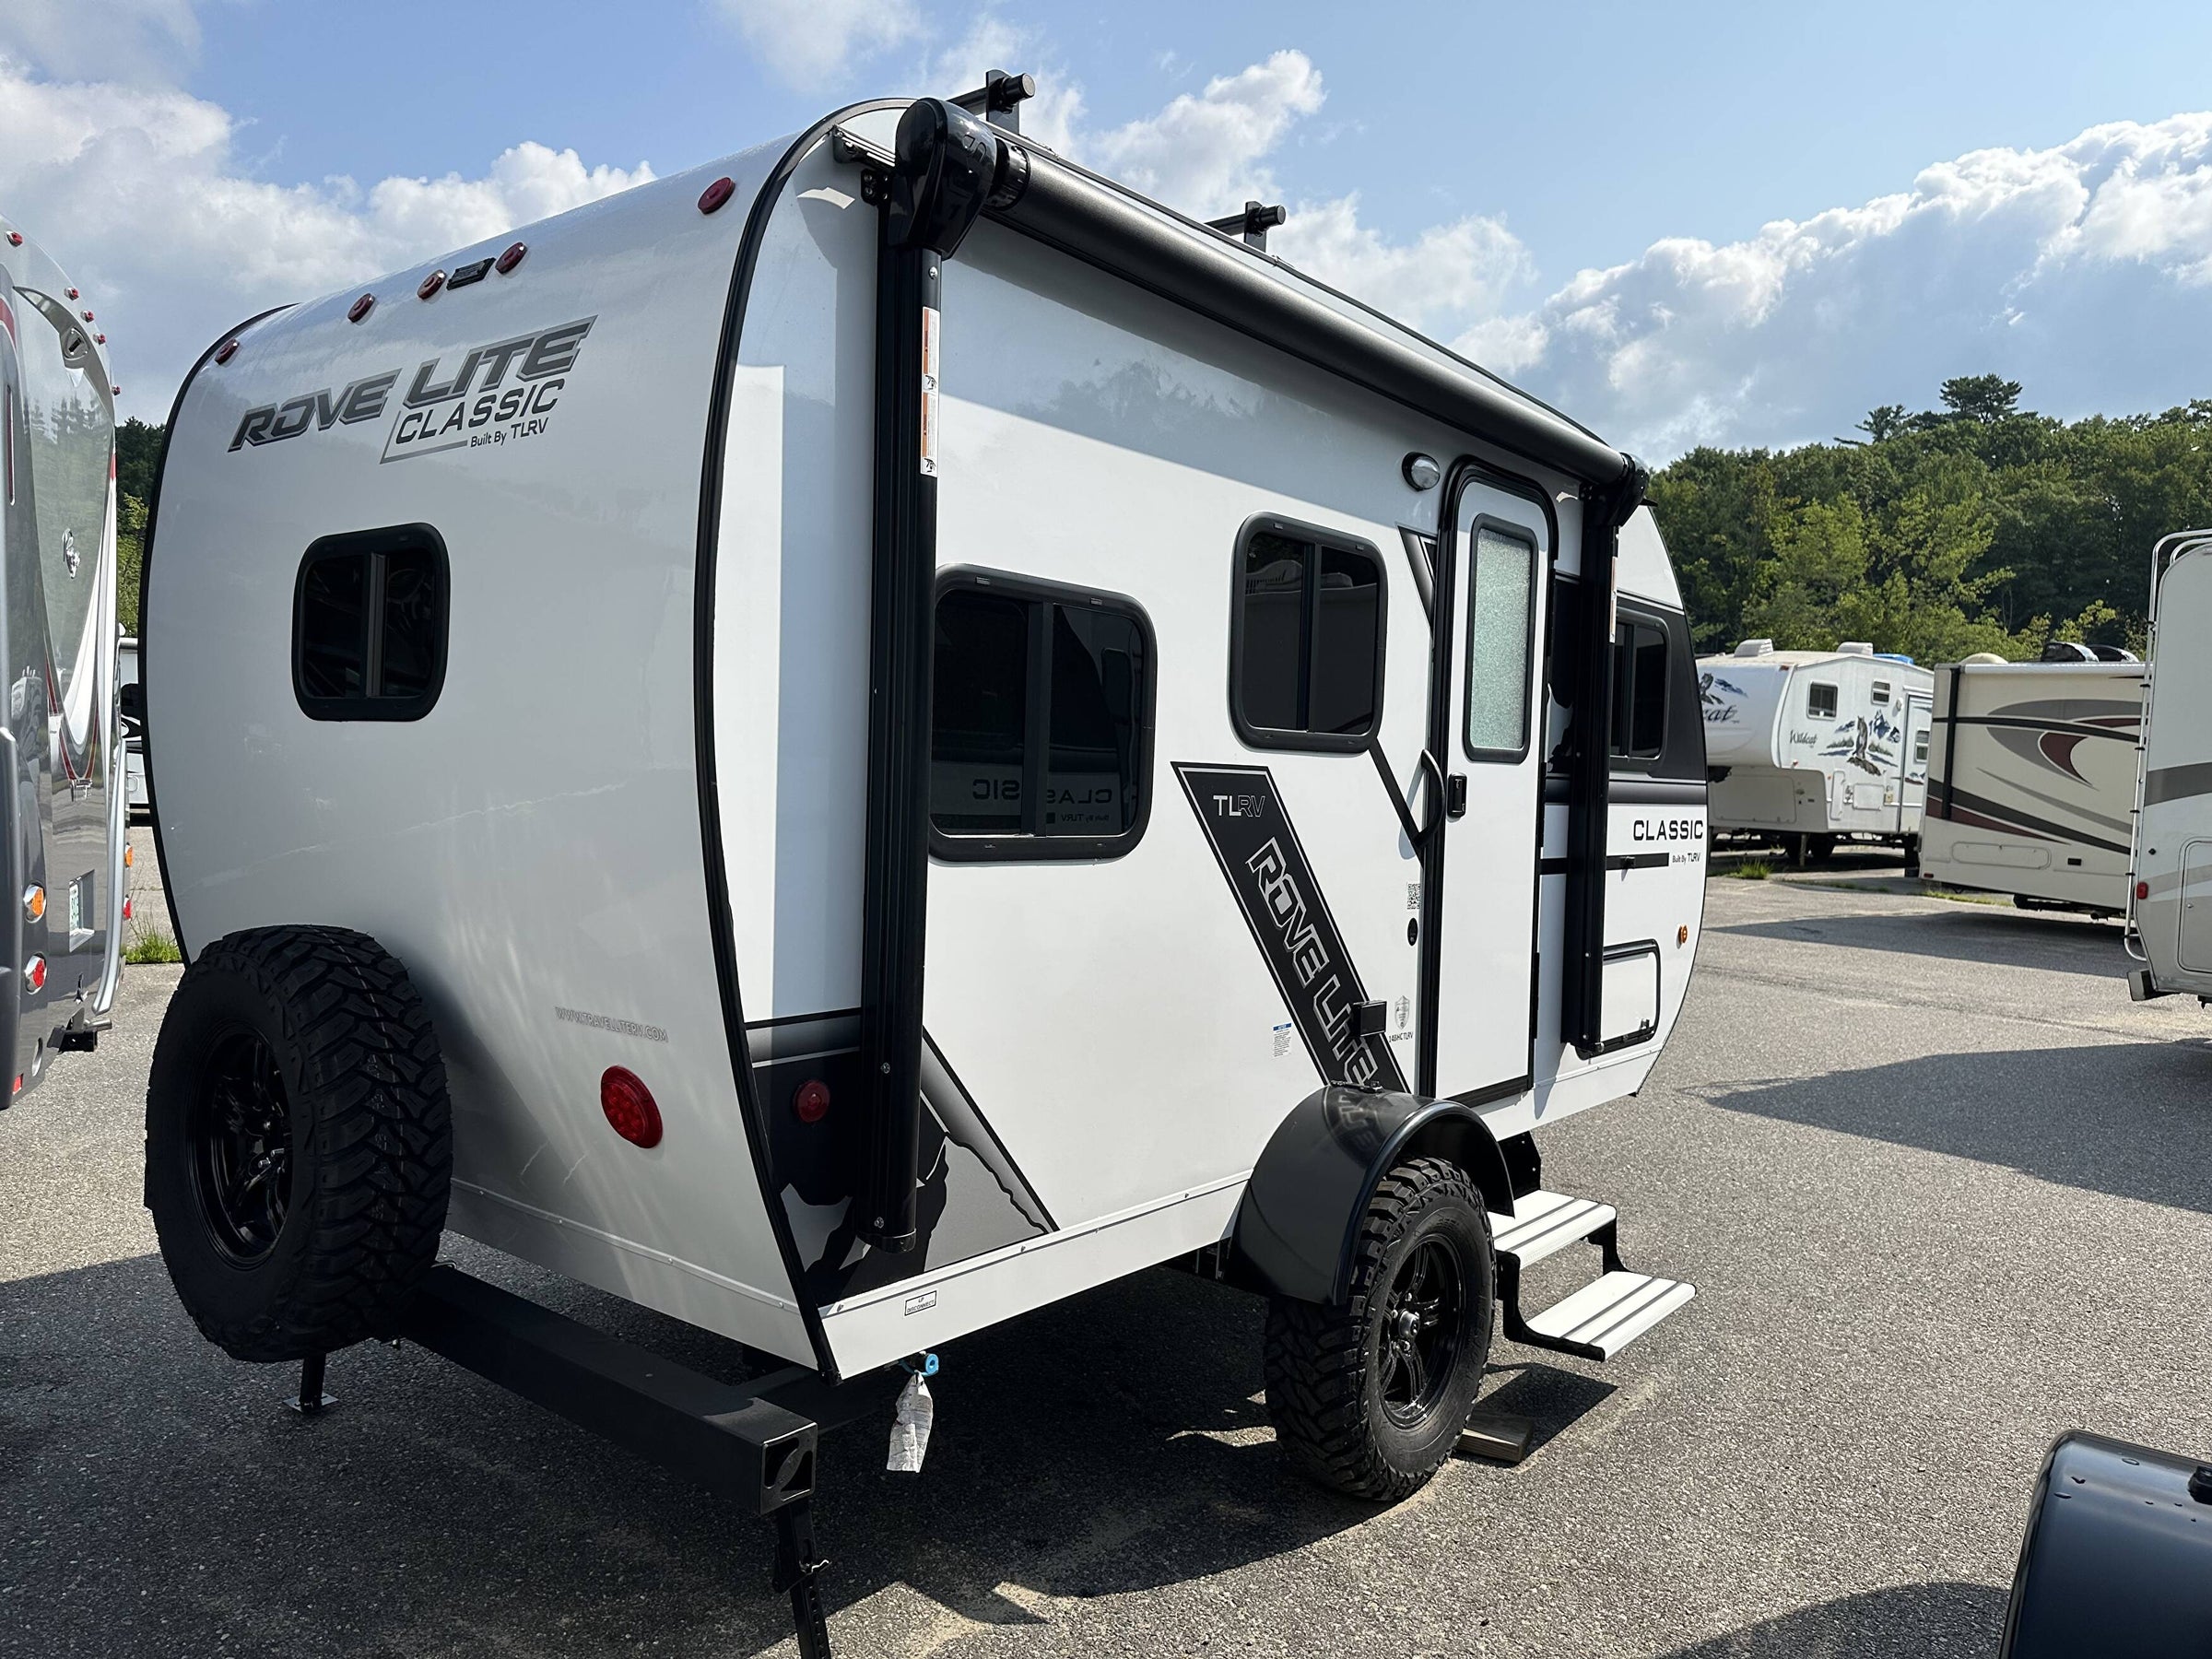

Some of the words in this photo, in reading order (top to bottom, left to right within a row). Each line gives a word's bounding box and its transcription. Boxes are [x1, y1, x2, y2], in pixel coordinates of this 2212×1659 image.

[228, 368, 402, 453] ROVE
[403, 314, 598, 407] LITE
[395, 378, 565, 444] CLASSIC
[470, 434, 492, 448] Built
[494, 431, 507, 447] By
[510, 417, 549, 440] TLRV
[1213, 794, 1265, 818] TLRV
[1633, 820, 1703, 841] CLASSIC
[1688, 853, 1700, 862] TLRV
[1244, 836, 1330, 989] ROVE
[907, 1300, 935, 1312] DISCONNECT
